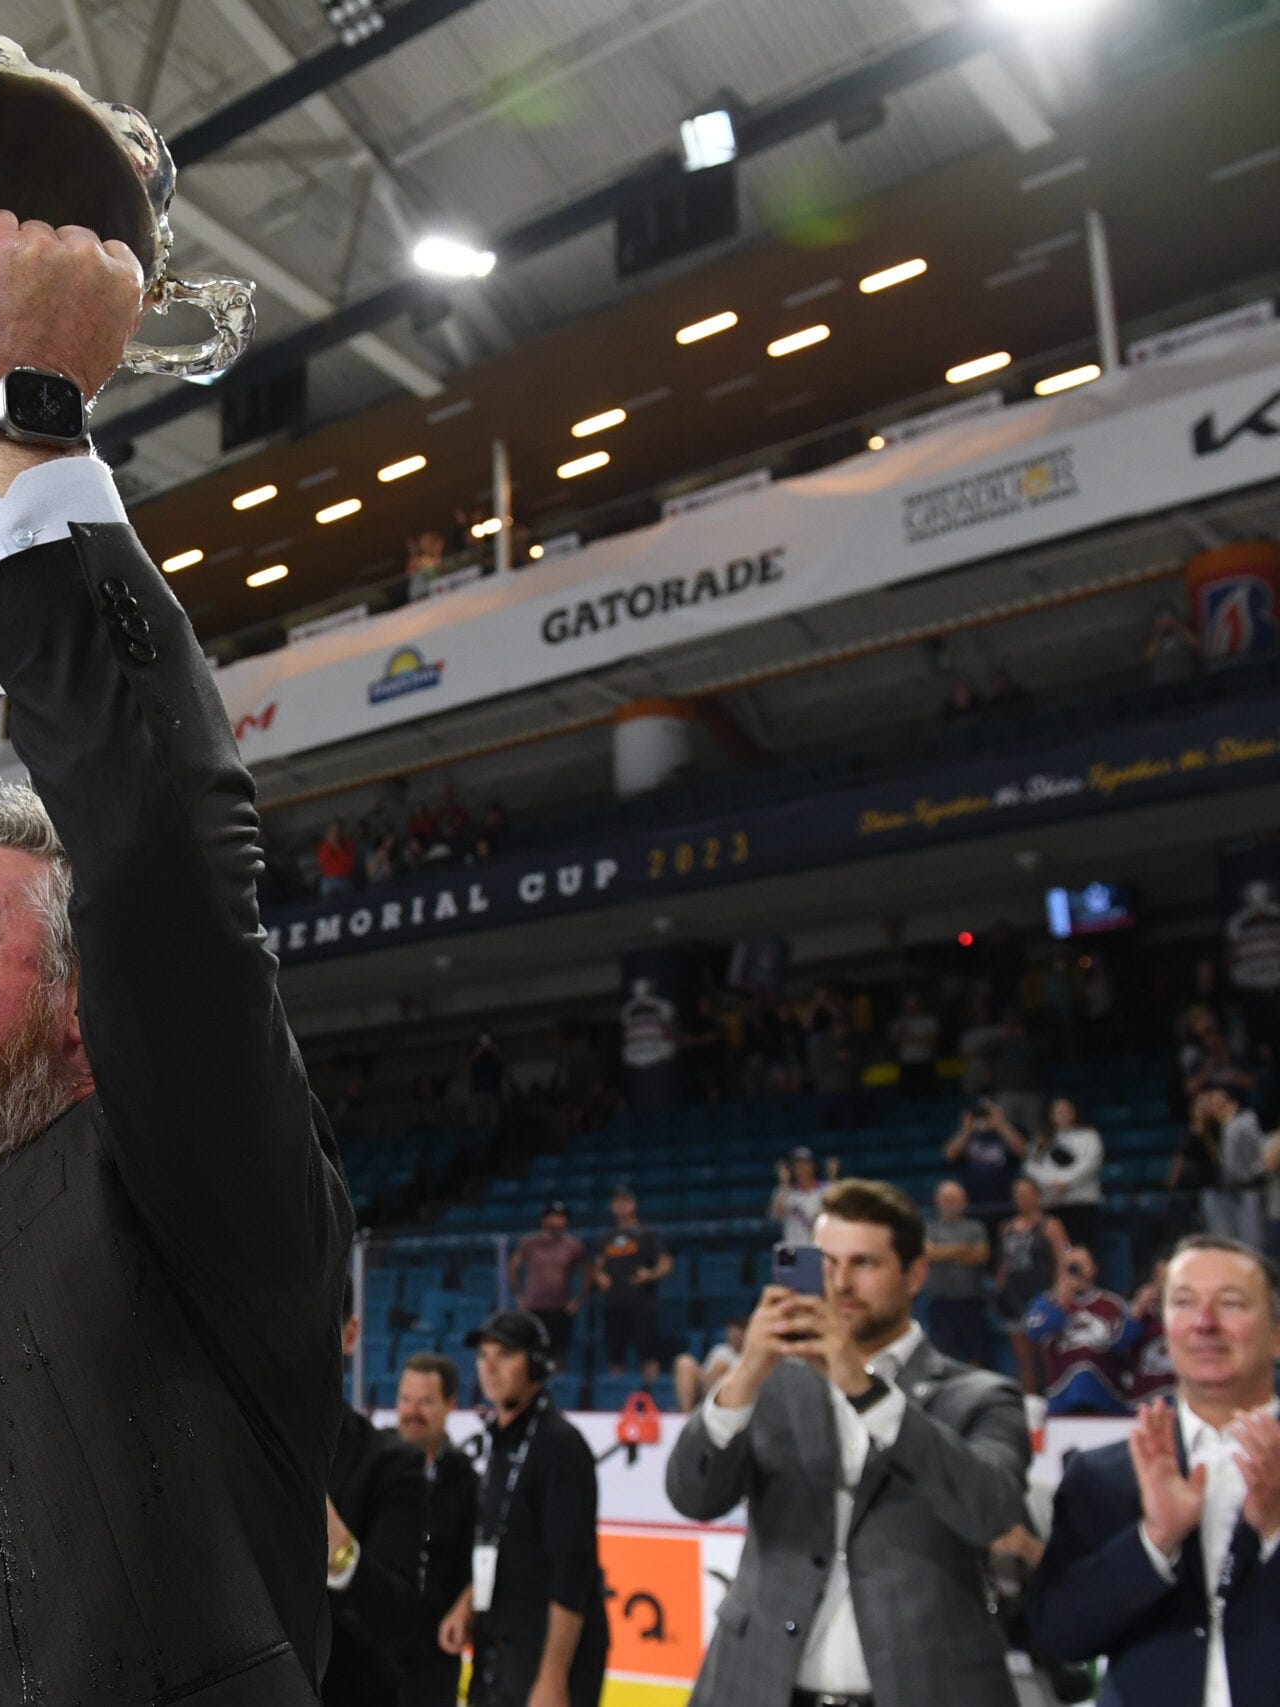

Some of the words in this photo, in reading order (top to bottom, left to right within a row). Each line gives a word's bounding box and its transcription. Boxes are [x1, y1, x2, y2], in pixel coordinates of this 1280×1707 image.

[542, 546, 787, 645] GATORADE
[517, 857, 618, 904] CUP
[647, 830, 749, 881] 2023
